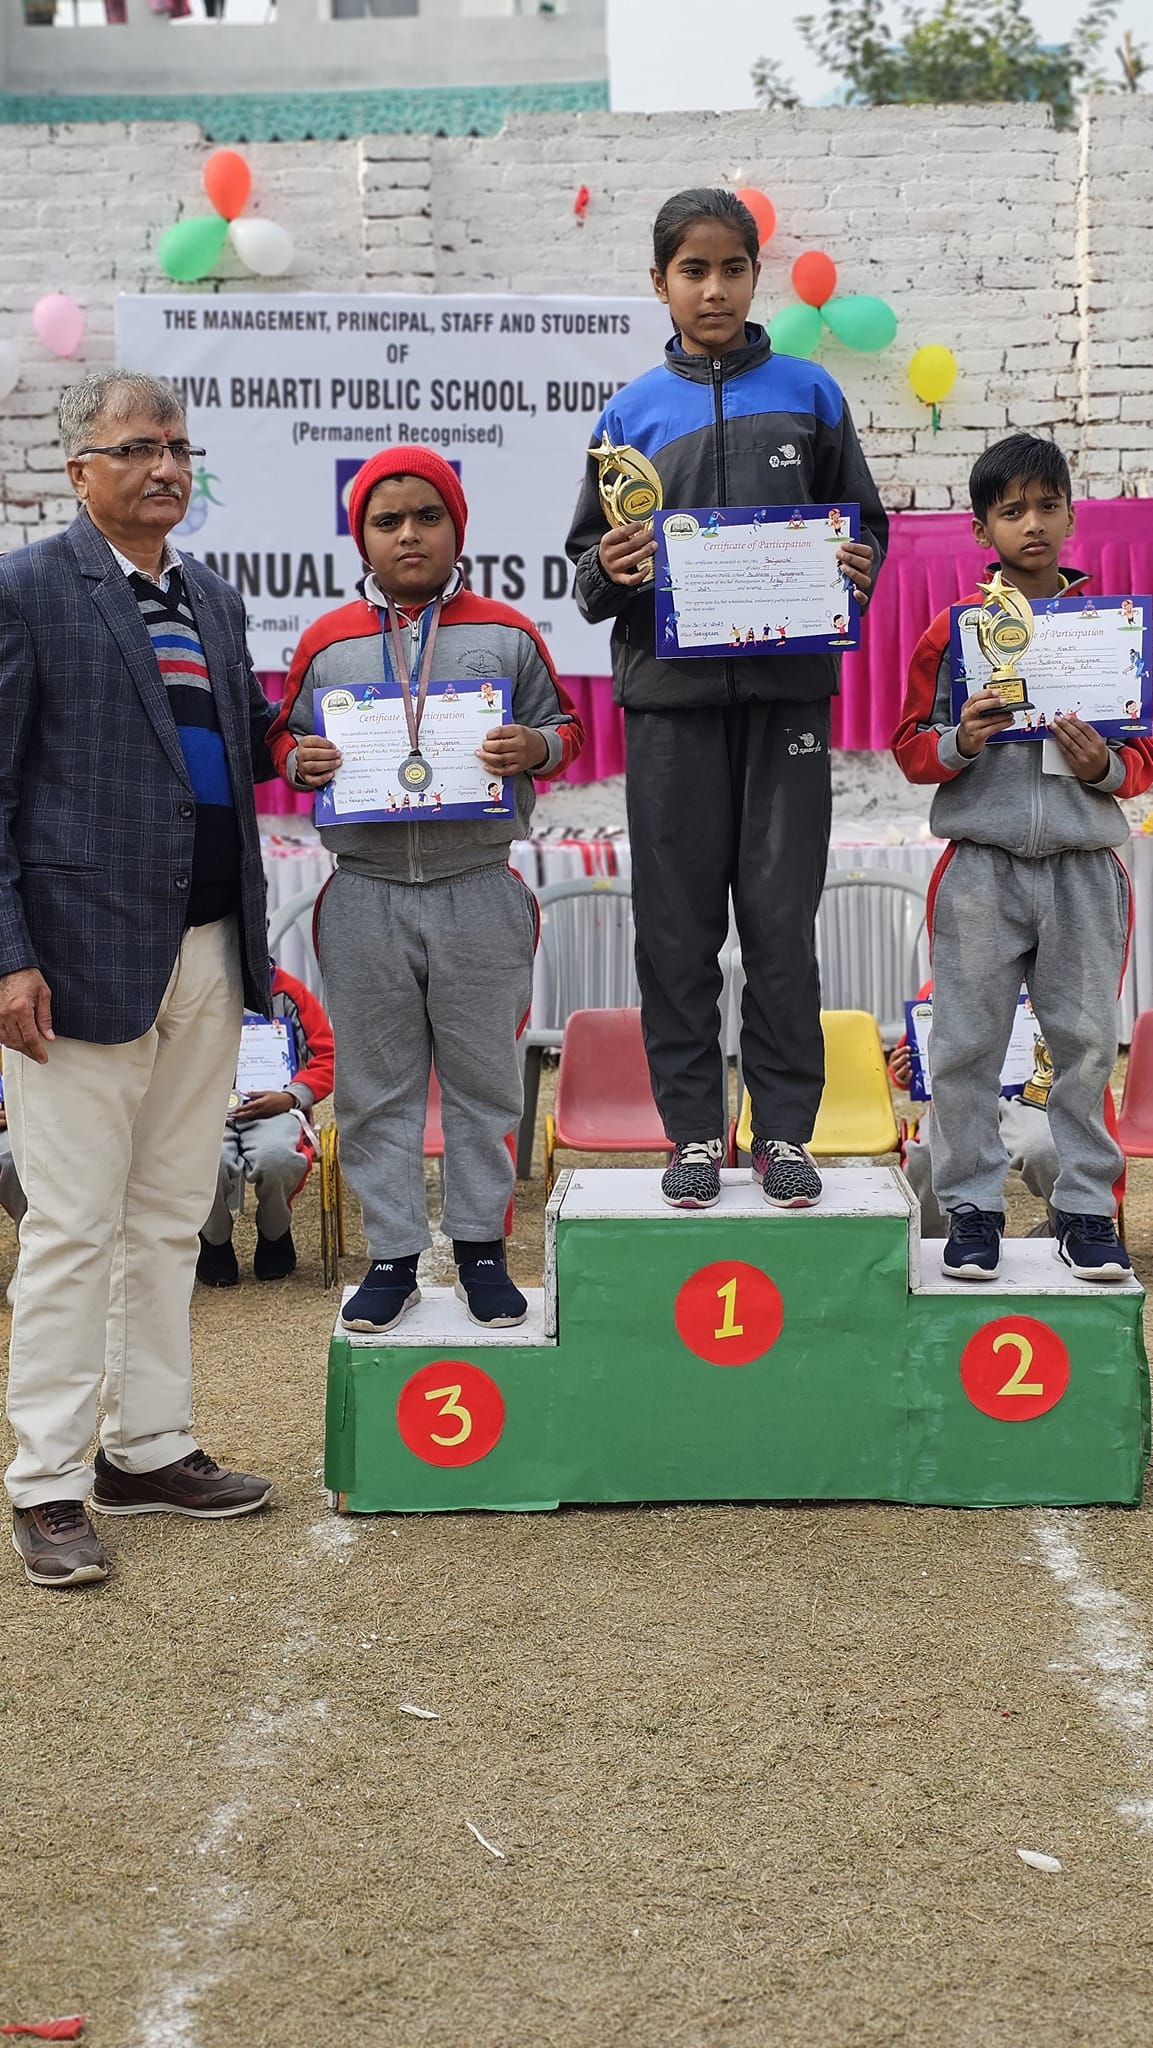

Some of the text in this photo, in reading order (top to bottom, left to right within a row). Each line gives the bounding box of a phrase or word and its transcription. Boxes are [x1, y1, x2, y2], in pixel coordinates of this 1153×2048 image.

[164, 309, 630, 335] THE MANAGEMENT, PRINCIPAL, STAFF AND STUDENTS
[386, 343, 409, 364] OF
[230, 377, 321, 409] BHARTI
[331, 378, 421, 411] PUBLIC
[430, 379, 537, 417] SCHOOL,
[292, 421, 504, 448] (Permanent Recognised)
[703, 539, 812, 553] Certificate of Participation
[188, 551, 345, 598] NNUAL
[246, 614, 299, 632] E-mail
[1040, 629, 1104, 640] of Participation
[359, 712, 465, 724] Certificate rticipation
[374, 1263, 394, 1272] AIR
[476, 1259, 495, 1267] AIR
[714, 1277, 744, 1340] 1
[992, 1332, 1044, 1396] 2
[424, 1384, 473, 1447] 3
